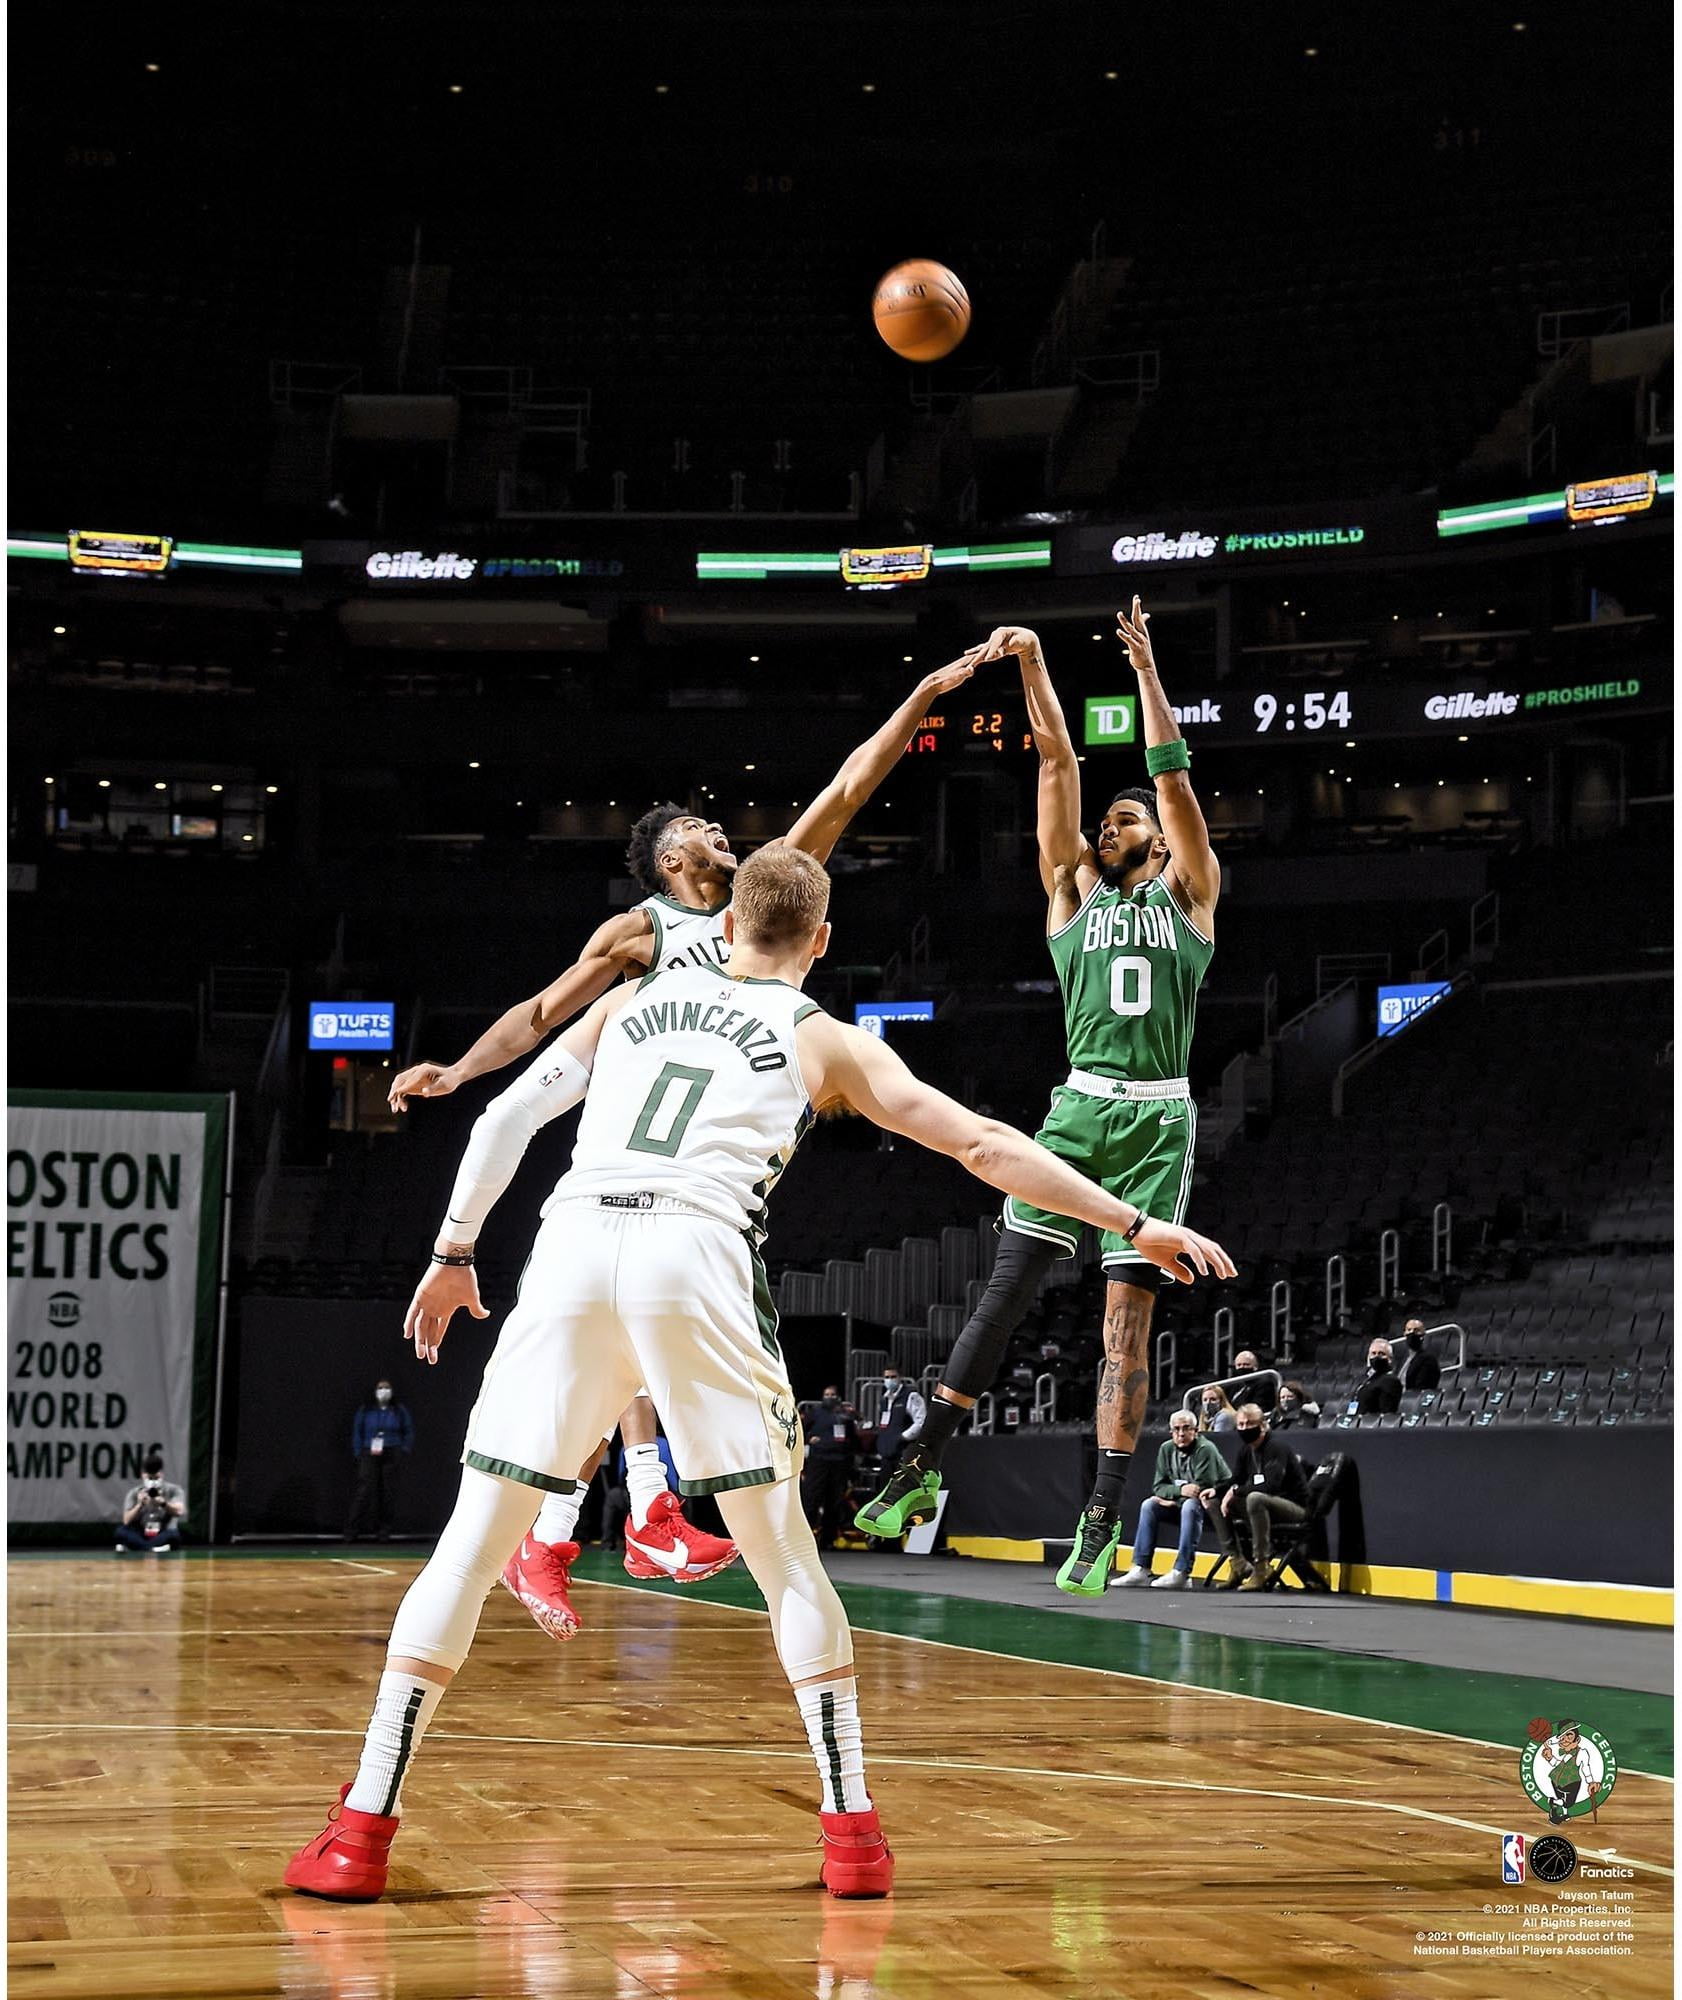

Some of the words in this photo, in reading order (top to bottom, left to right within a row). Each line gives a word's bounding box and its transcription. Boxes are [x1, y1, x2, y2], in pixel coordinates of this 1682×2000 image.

[1111, 531, 1217, 562] Gillette
[1225, 527, 1364, 552] #PROSHIELD
[366, 551, 476, 579] Gillette
[1090, 705, 1130, 735] TD
[1172, 699, 1222, 724] ank
[1253, 691, 1351, 732] 9:54
[1424, 691, 1519, 720] Gillette
[1525, 680, 1640, 709] #PROSHIELD
[973, 714, 1002, 734] 2.2
[992, 739, 1002, 751] 4
[1083, 902, 1178, 953] BOSTON
[1110, 956, 1152, 1016] 0
[338, 1013, 391, 1028] TUFTS
[621, 1001, 787, 1073] DIVINCENZO
[626, 1061, 715, 1159] 0
[7, 1149, 181, 1210] OSTON
[50, 1303, 80, 1318] NBA
[16, 1341, 103, 1379] 2008
[7, 1442, 163, 1479] AMPION
